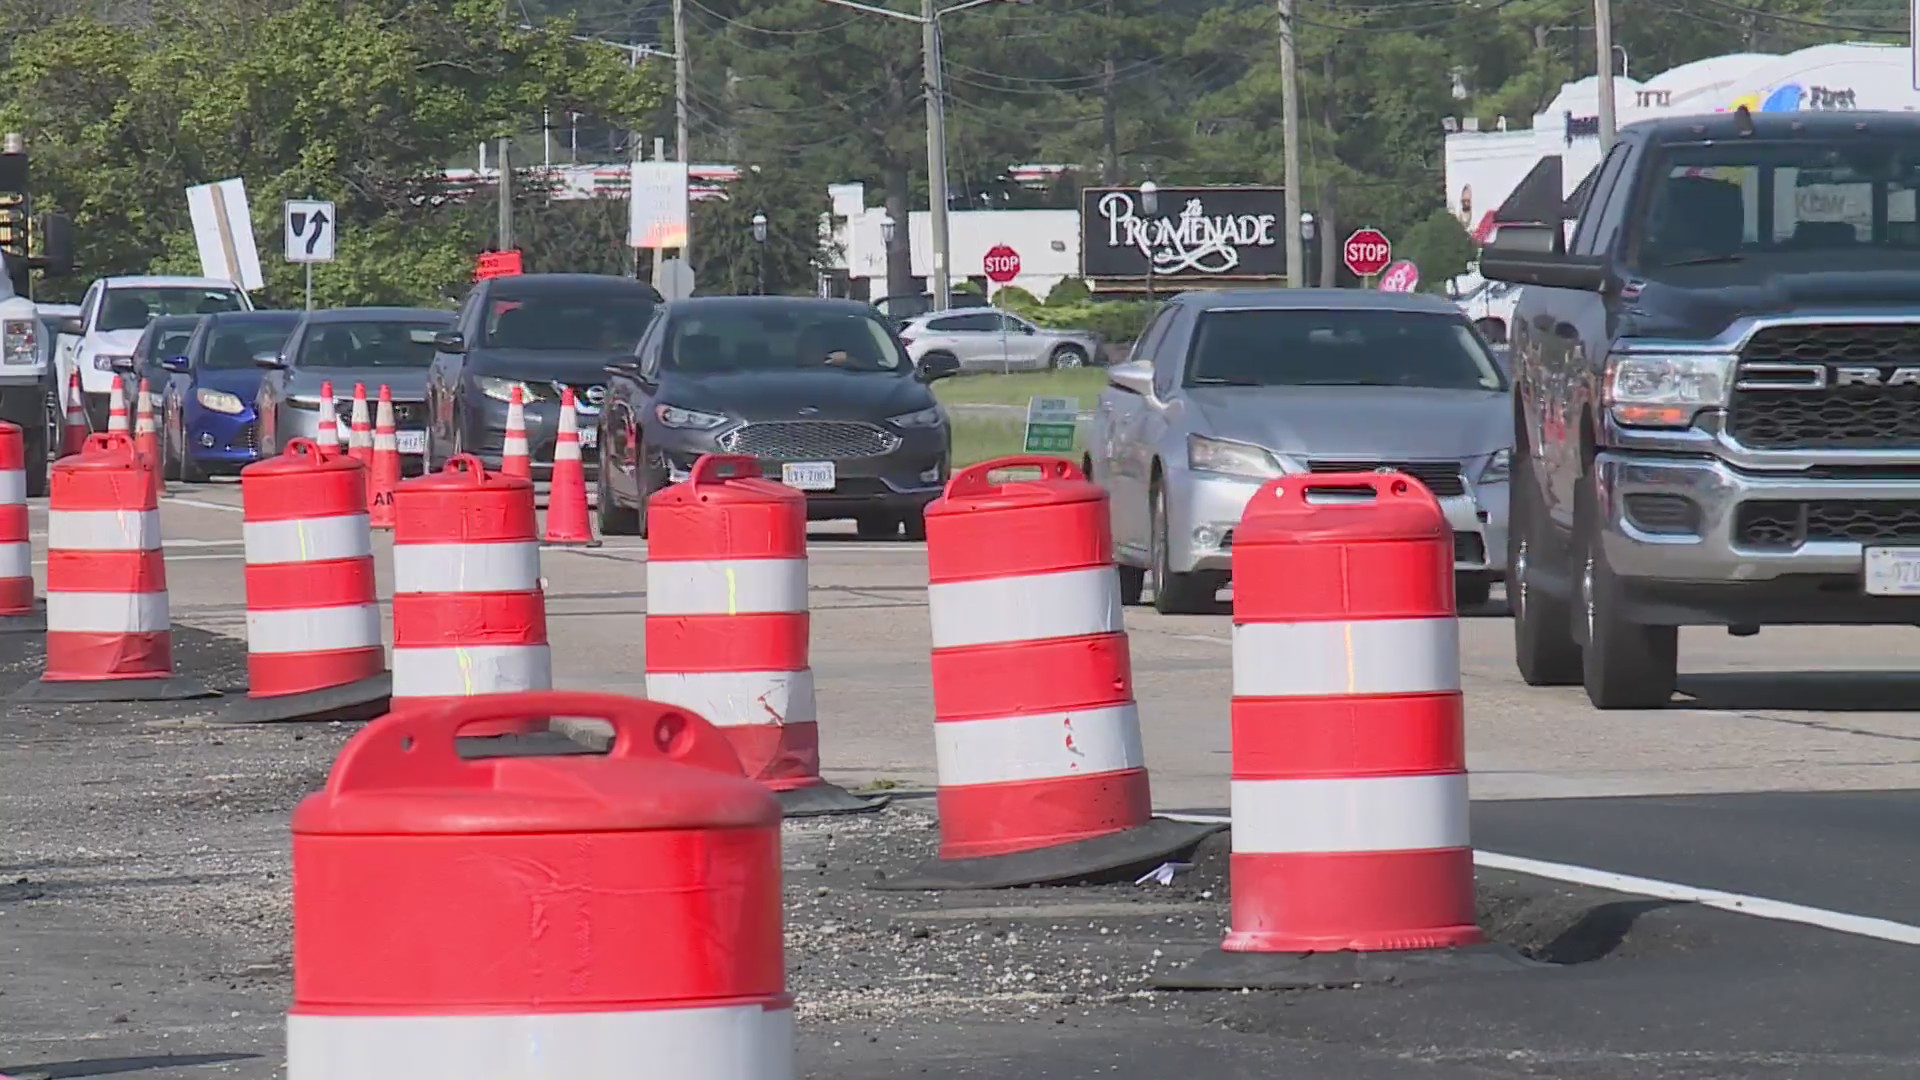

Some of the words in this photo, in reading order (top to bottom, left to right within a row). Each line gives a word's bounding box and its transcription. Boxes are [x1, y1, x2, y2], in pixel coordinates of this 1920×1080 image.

[1098, 192, 1275, 274] PROMENADE
[1348, 243, 1388, 262] STOP
[985, 255, 1019, 272] STOP
